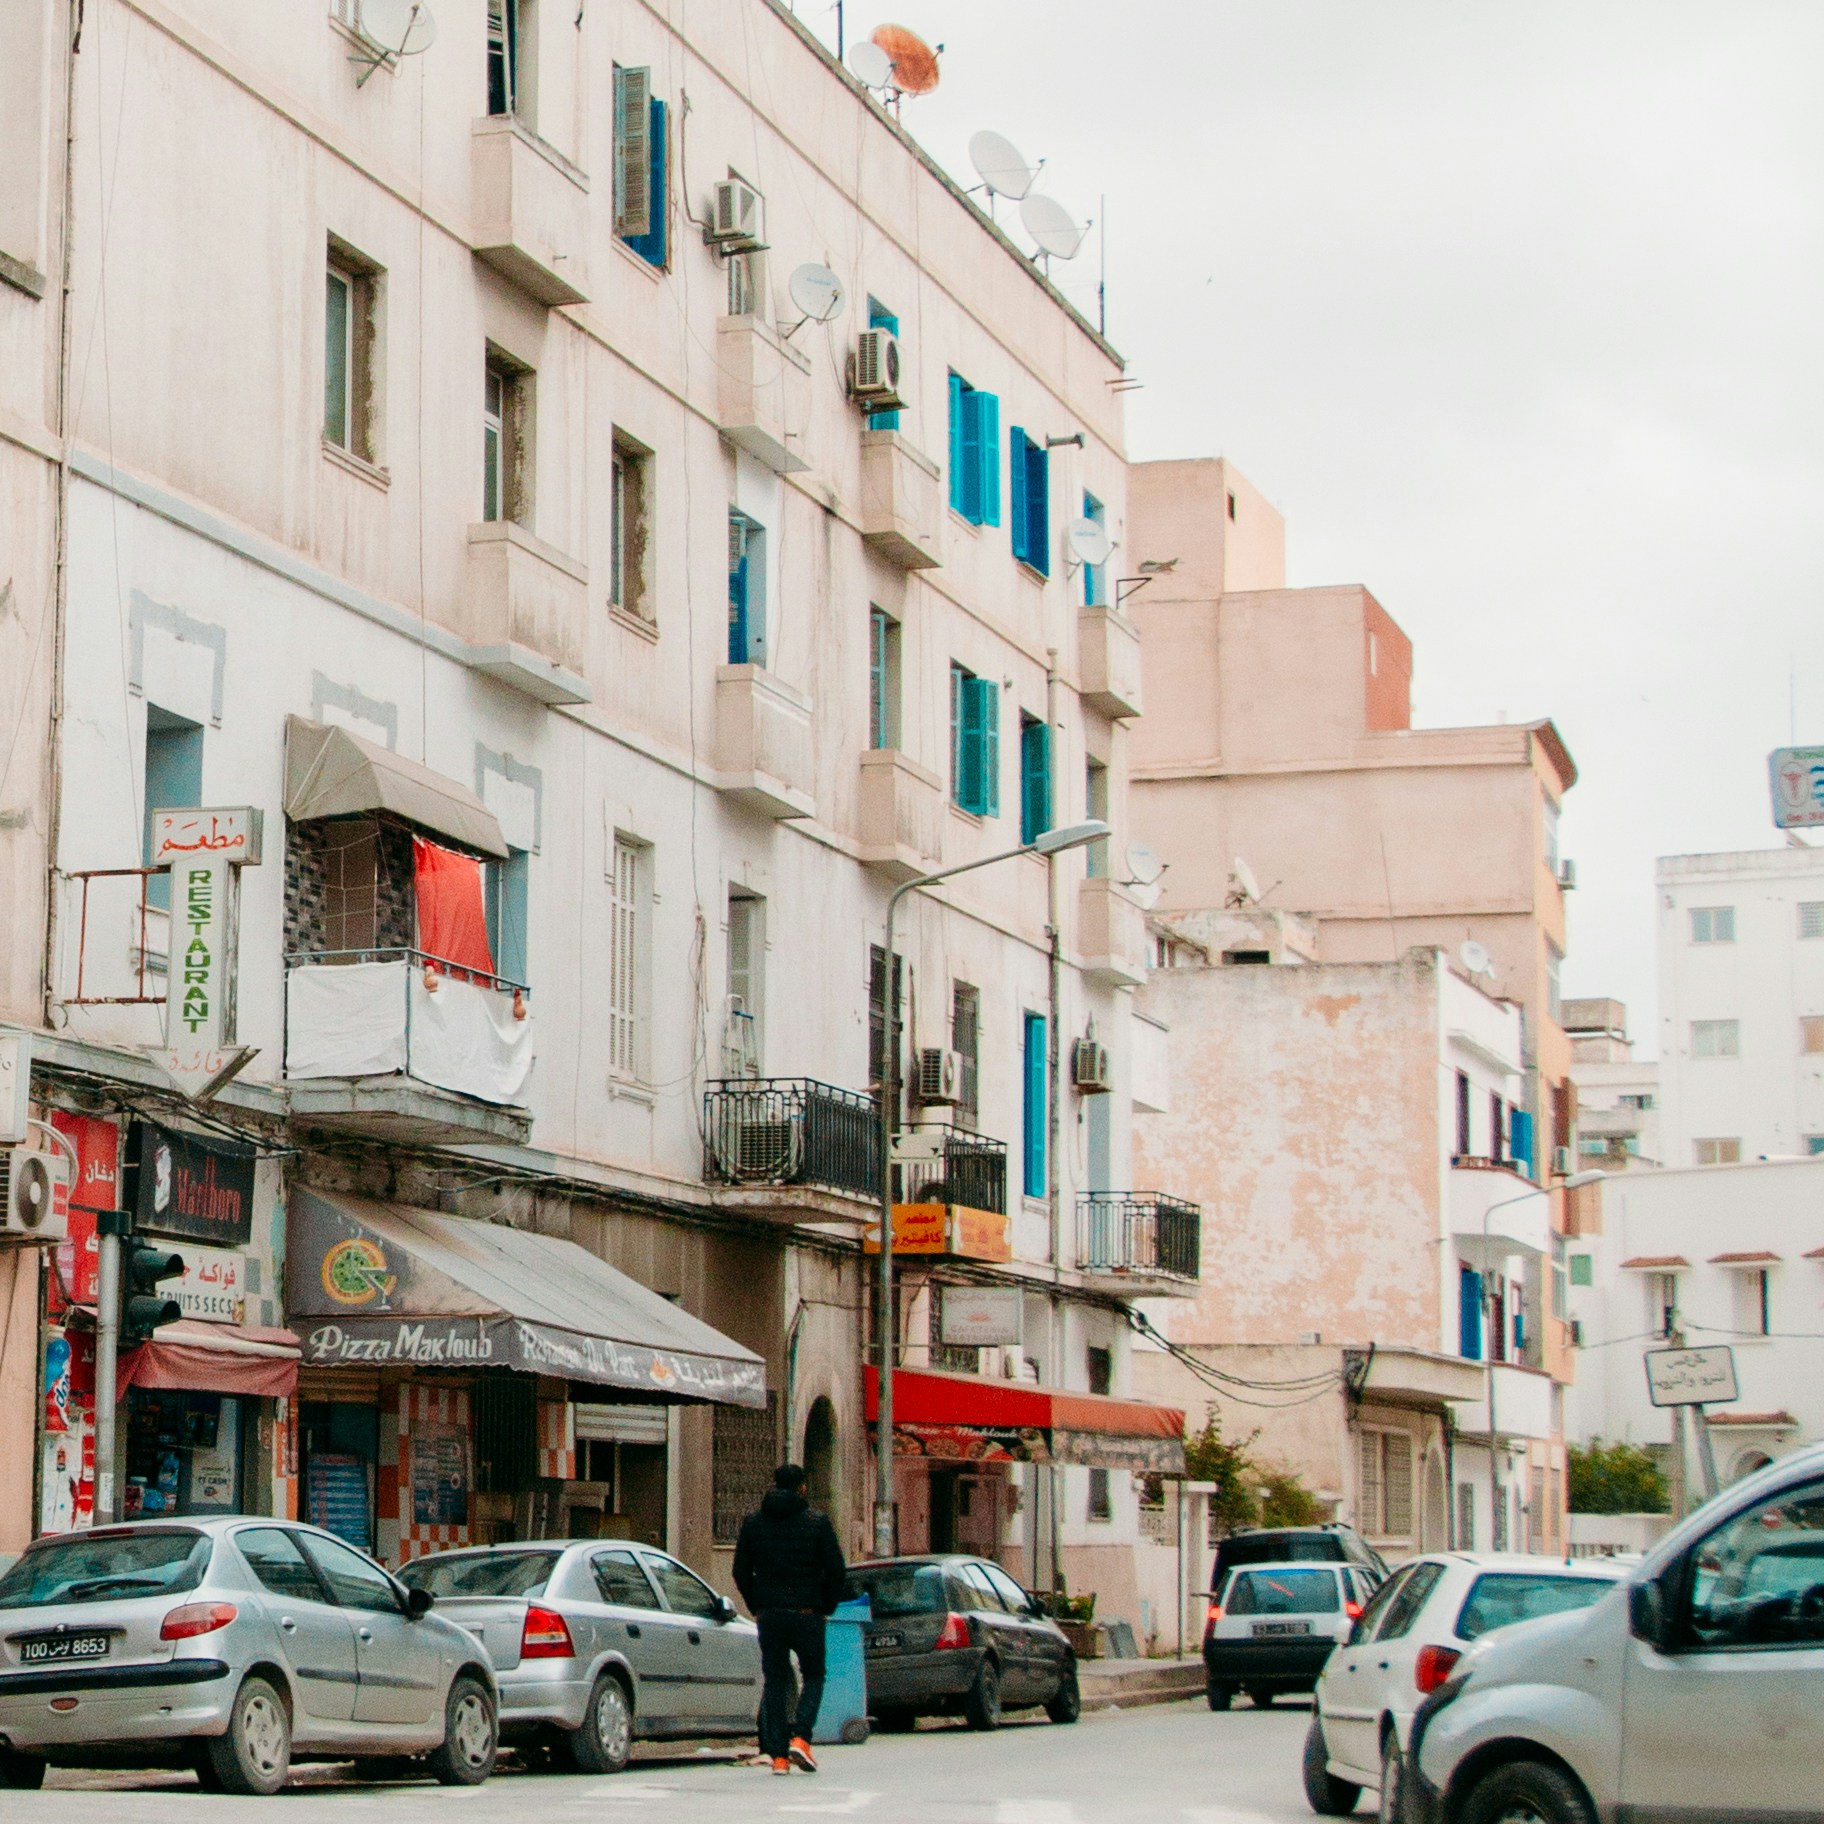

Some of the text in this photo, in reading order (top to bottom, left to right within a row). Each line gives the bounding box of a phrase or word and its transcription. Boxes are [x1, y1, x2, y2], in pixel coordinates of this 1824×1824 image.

[182, 869, 212, 1034] RESTAURANT
[177, 1155, 242, 1225] Marlboro
[202, 1298, 232, 1315] SECS
[308, 1323, 493, 1362] Pizza Makloub
[25, 1643, 49, 1659] 100
[72, 1638, 107, 1655] 8653
